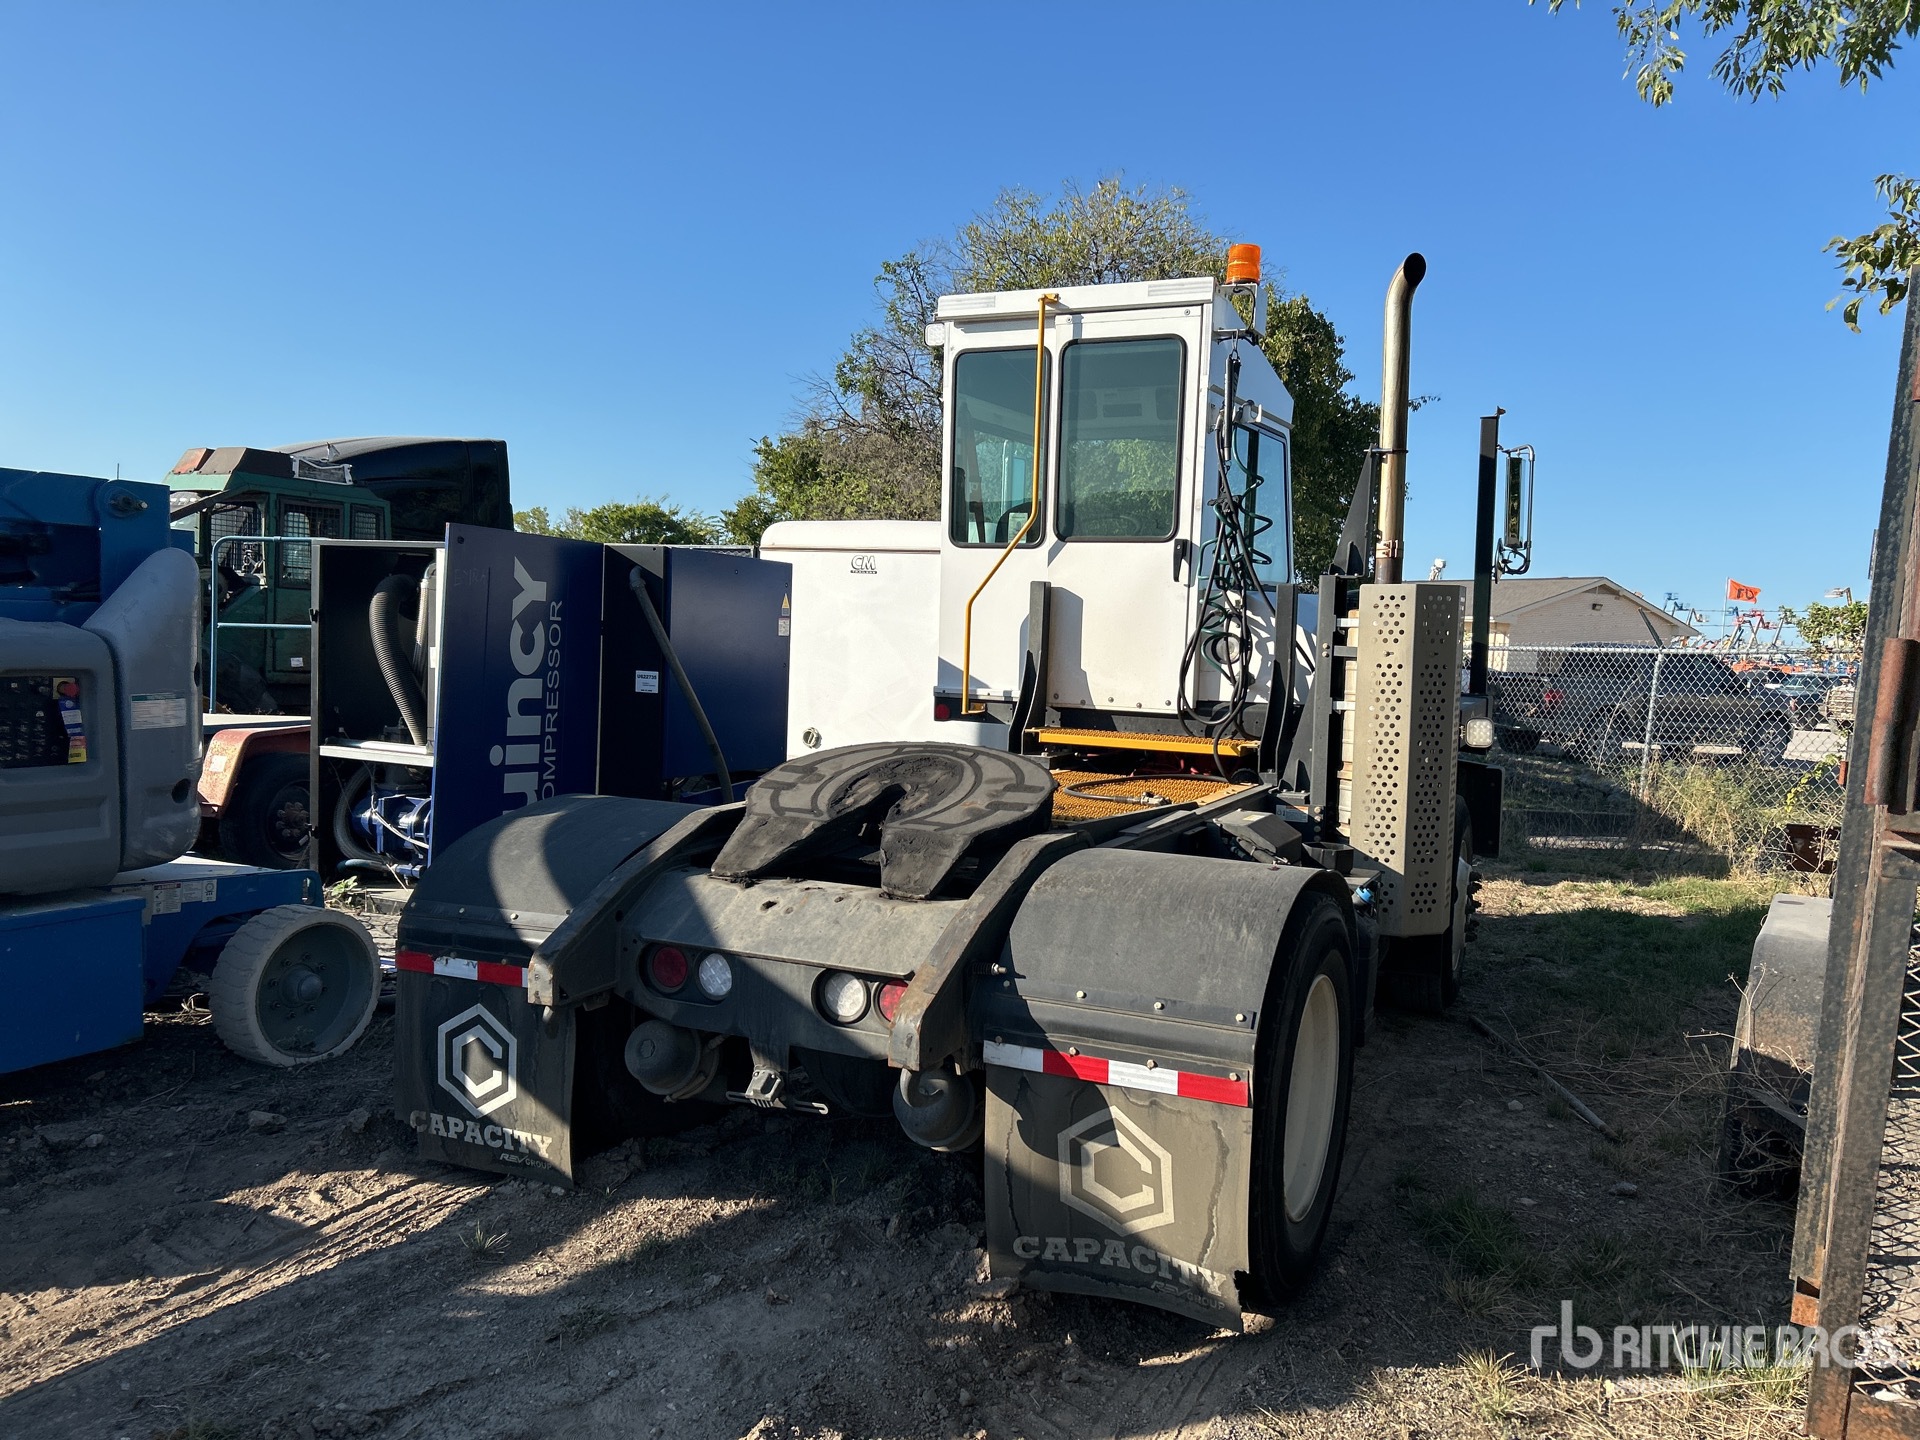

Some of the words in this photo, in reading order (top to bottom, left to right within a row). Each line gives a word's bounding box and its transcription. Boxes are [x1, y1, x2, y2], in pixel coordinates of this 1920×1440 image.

[851, 555, 876, 570] CM
[542, 600, 563, 800] OMPRESSOR
[410, 1110, 553, 1158] CAPACITY
[525, 1158, 552, 1170] GROUP
[1013, 1236, 1227, 1296] CAPACITY
[1187, 1292, 1225, 1309] GROUP
